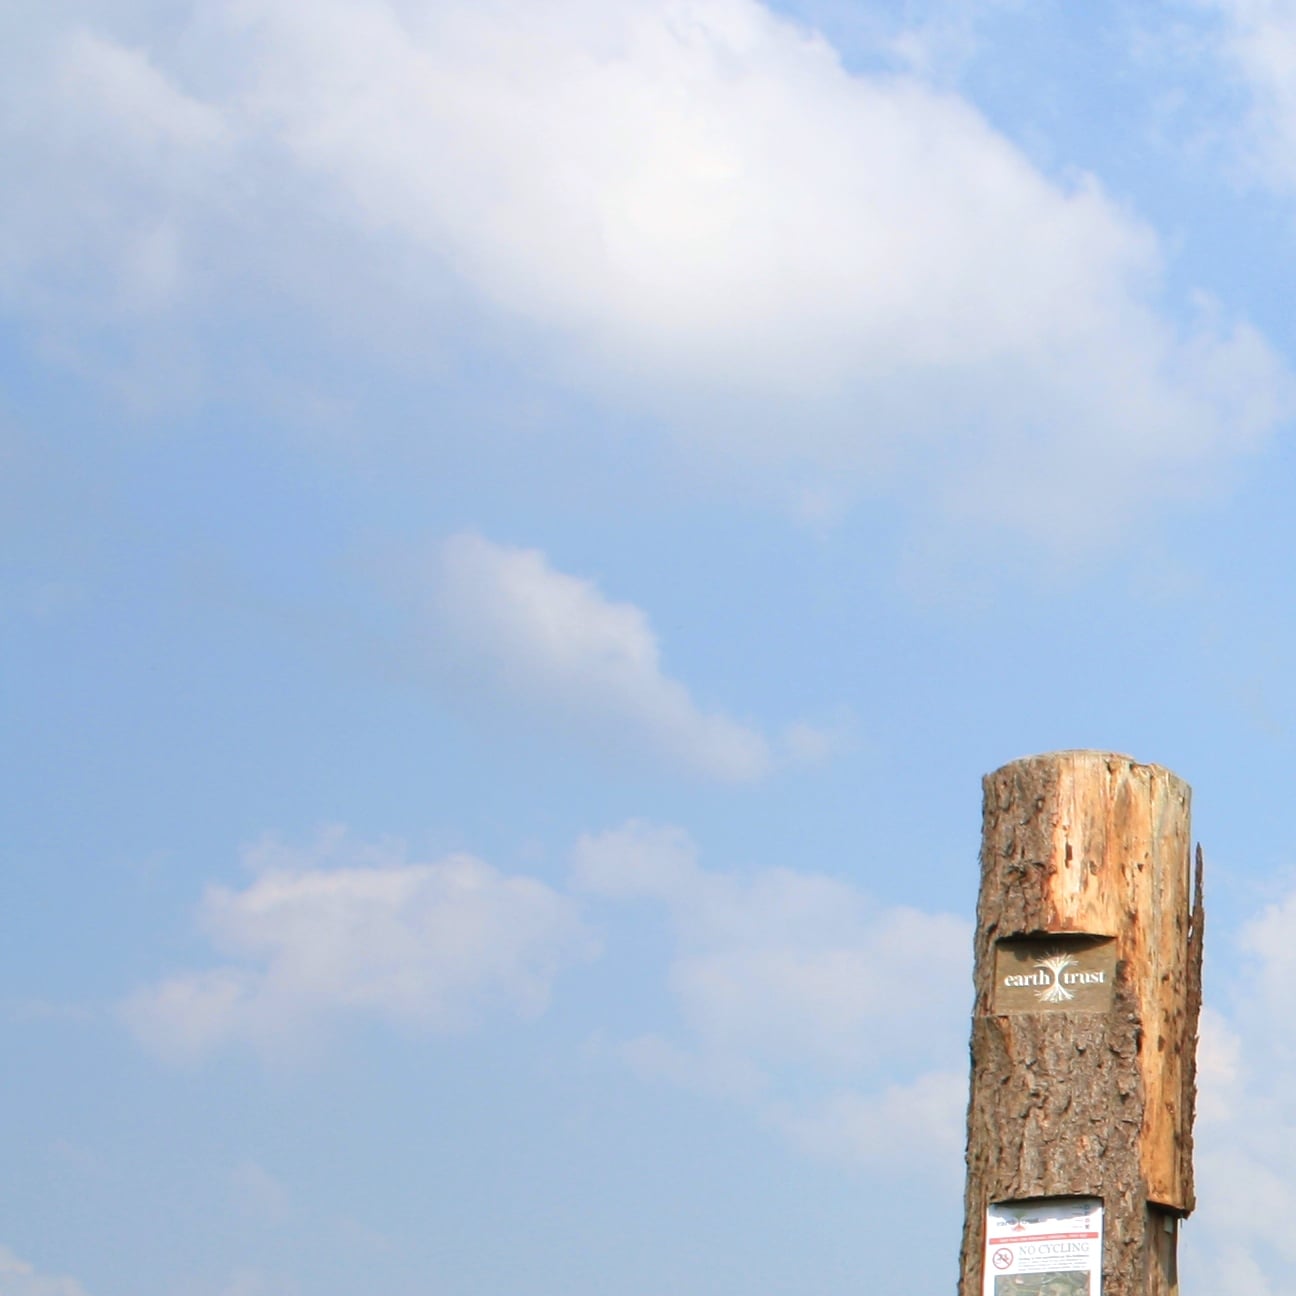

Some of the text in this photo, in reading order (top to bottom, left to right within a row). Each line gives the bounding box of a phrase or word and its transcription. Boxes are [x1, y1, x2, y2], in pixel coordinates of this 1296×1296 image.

[1004, 969, 1105, 987] earth trust
[1019, 1242, 1090, 1256] NO CYCLING
